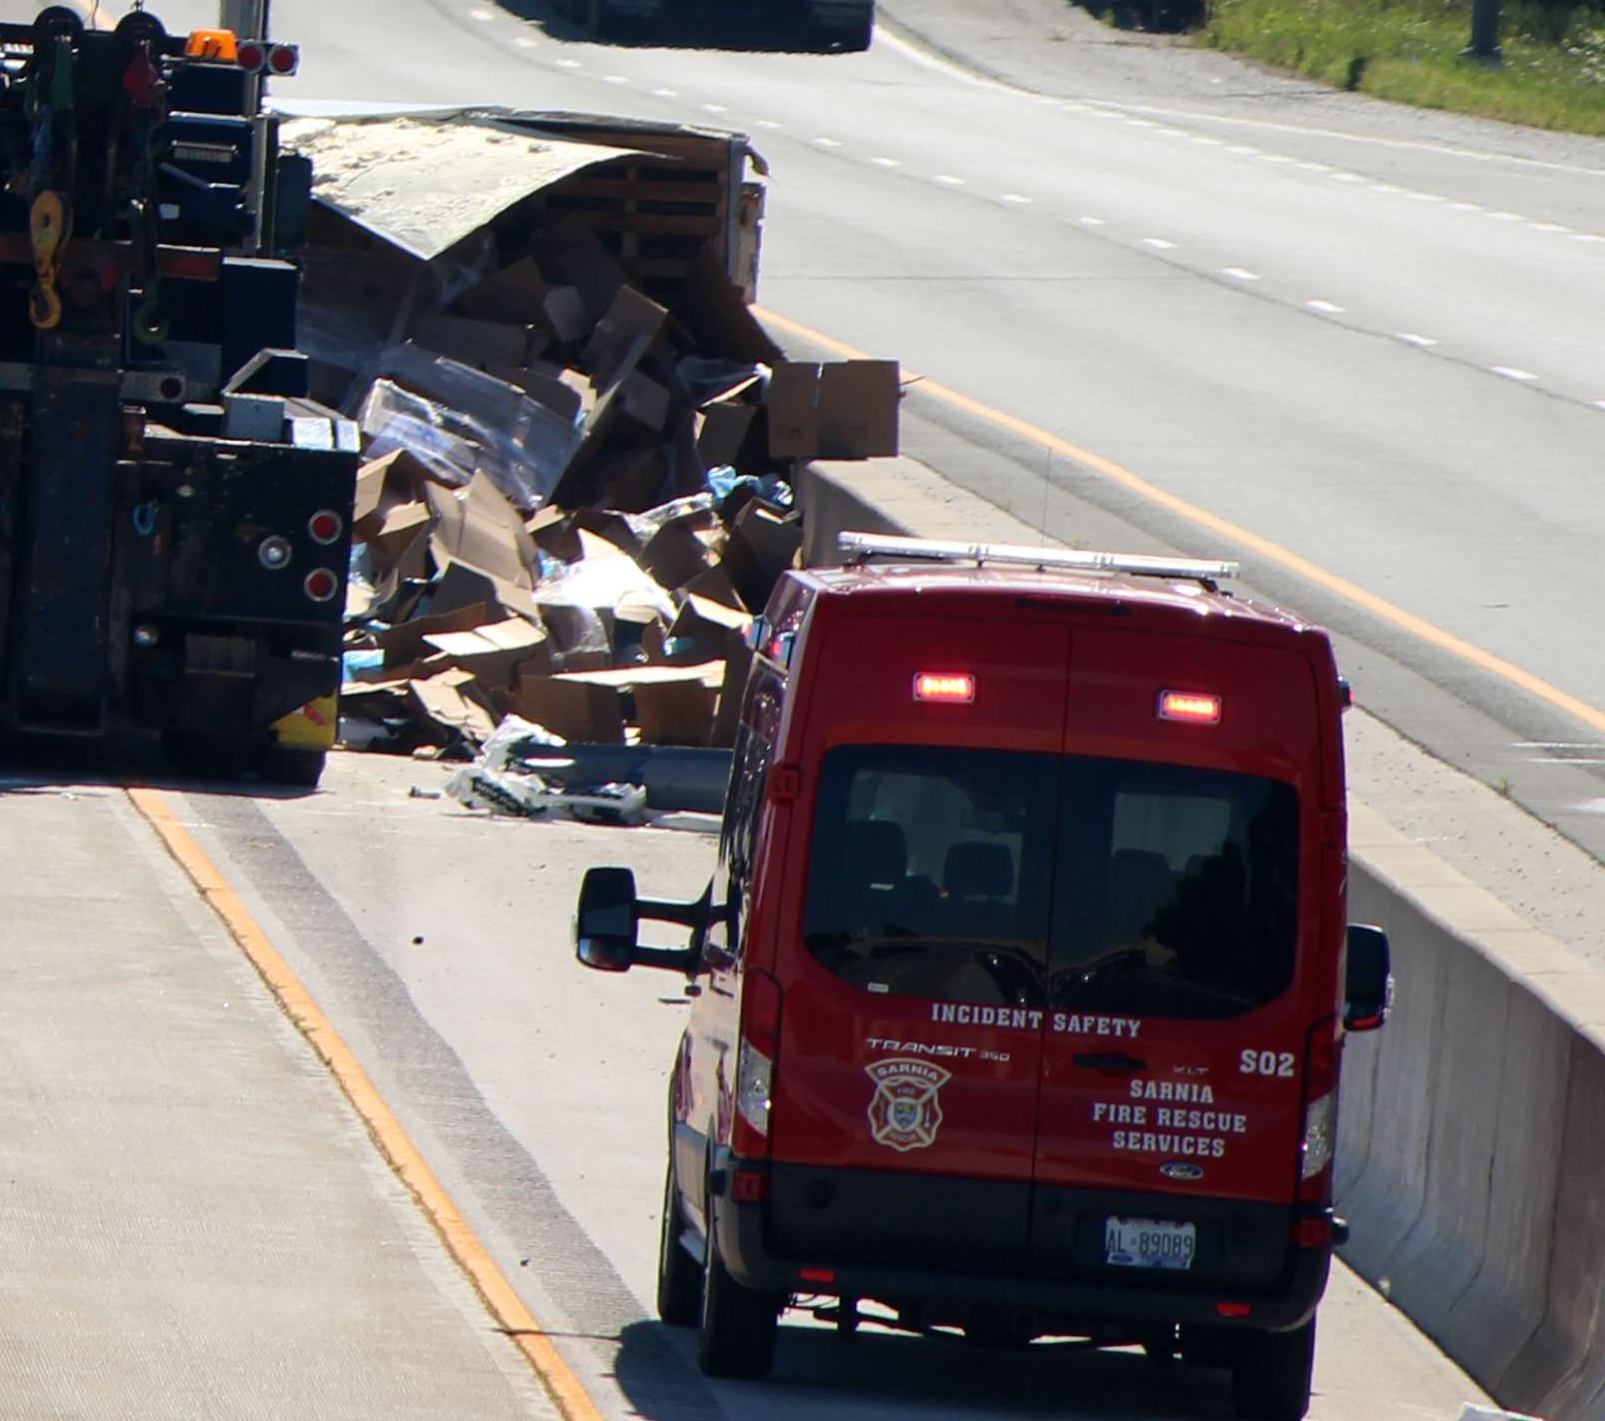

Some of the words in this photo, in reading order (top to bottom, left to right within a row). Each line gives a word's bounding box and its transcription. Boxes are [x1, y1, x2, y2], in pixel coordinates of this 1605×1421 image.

[931, 1003, 1043, 1029] INCIDENT
[1053, 1013, 1141, 1038] SAFETY
[865, 1038, 977, 1058] TRANSIT
[876, 1064, 938, 1081] SARNIA
[1130, 1080, 1214, 1104] SARNIA
[1093, 1103, 1147, 1125] FIRE
[1157, 1108, 1247, 1133] RESCUE
[1113, 1131, 1225, 1157] SERVICES
